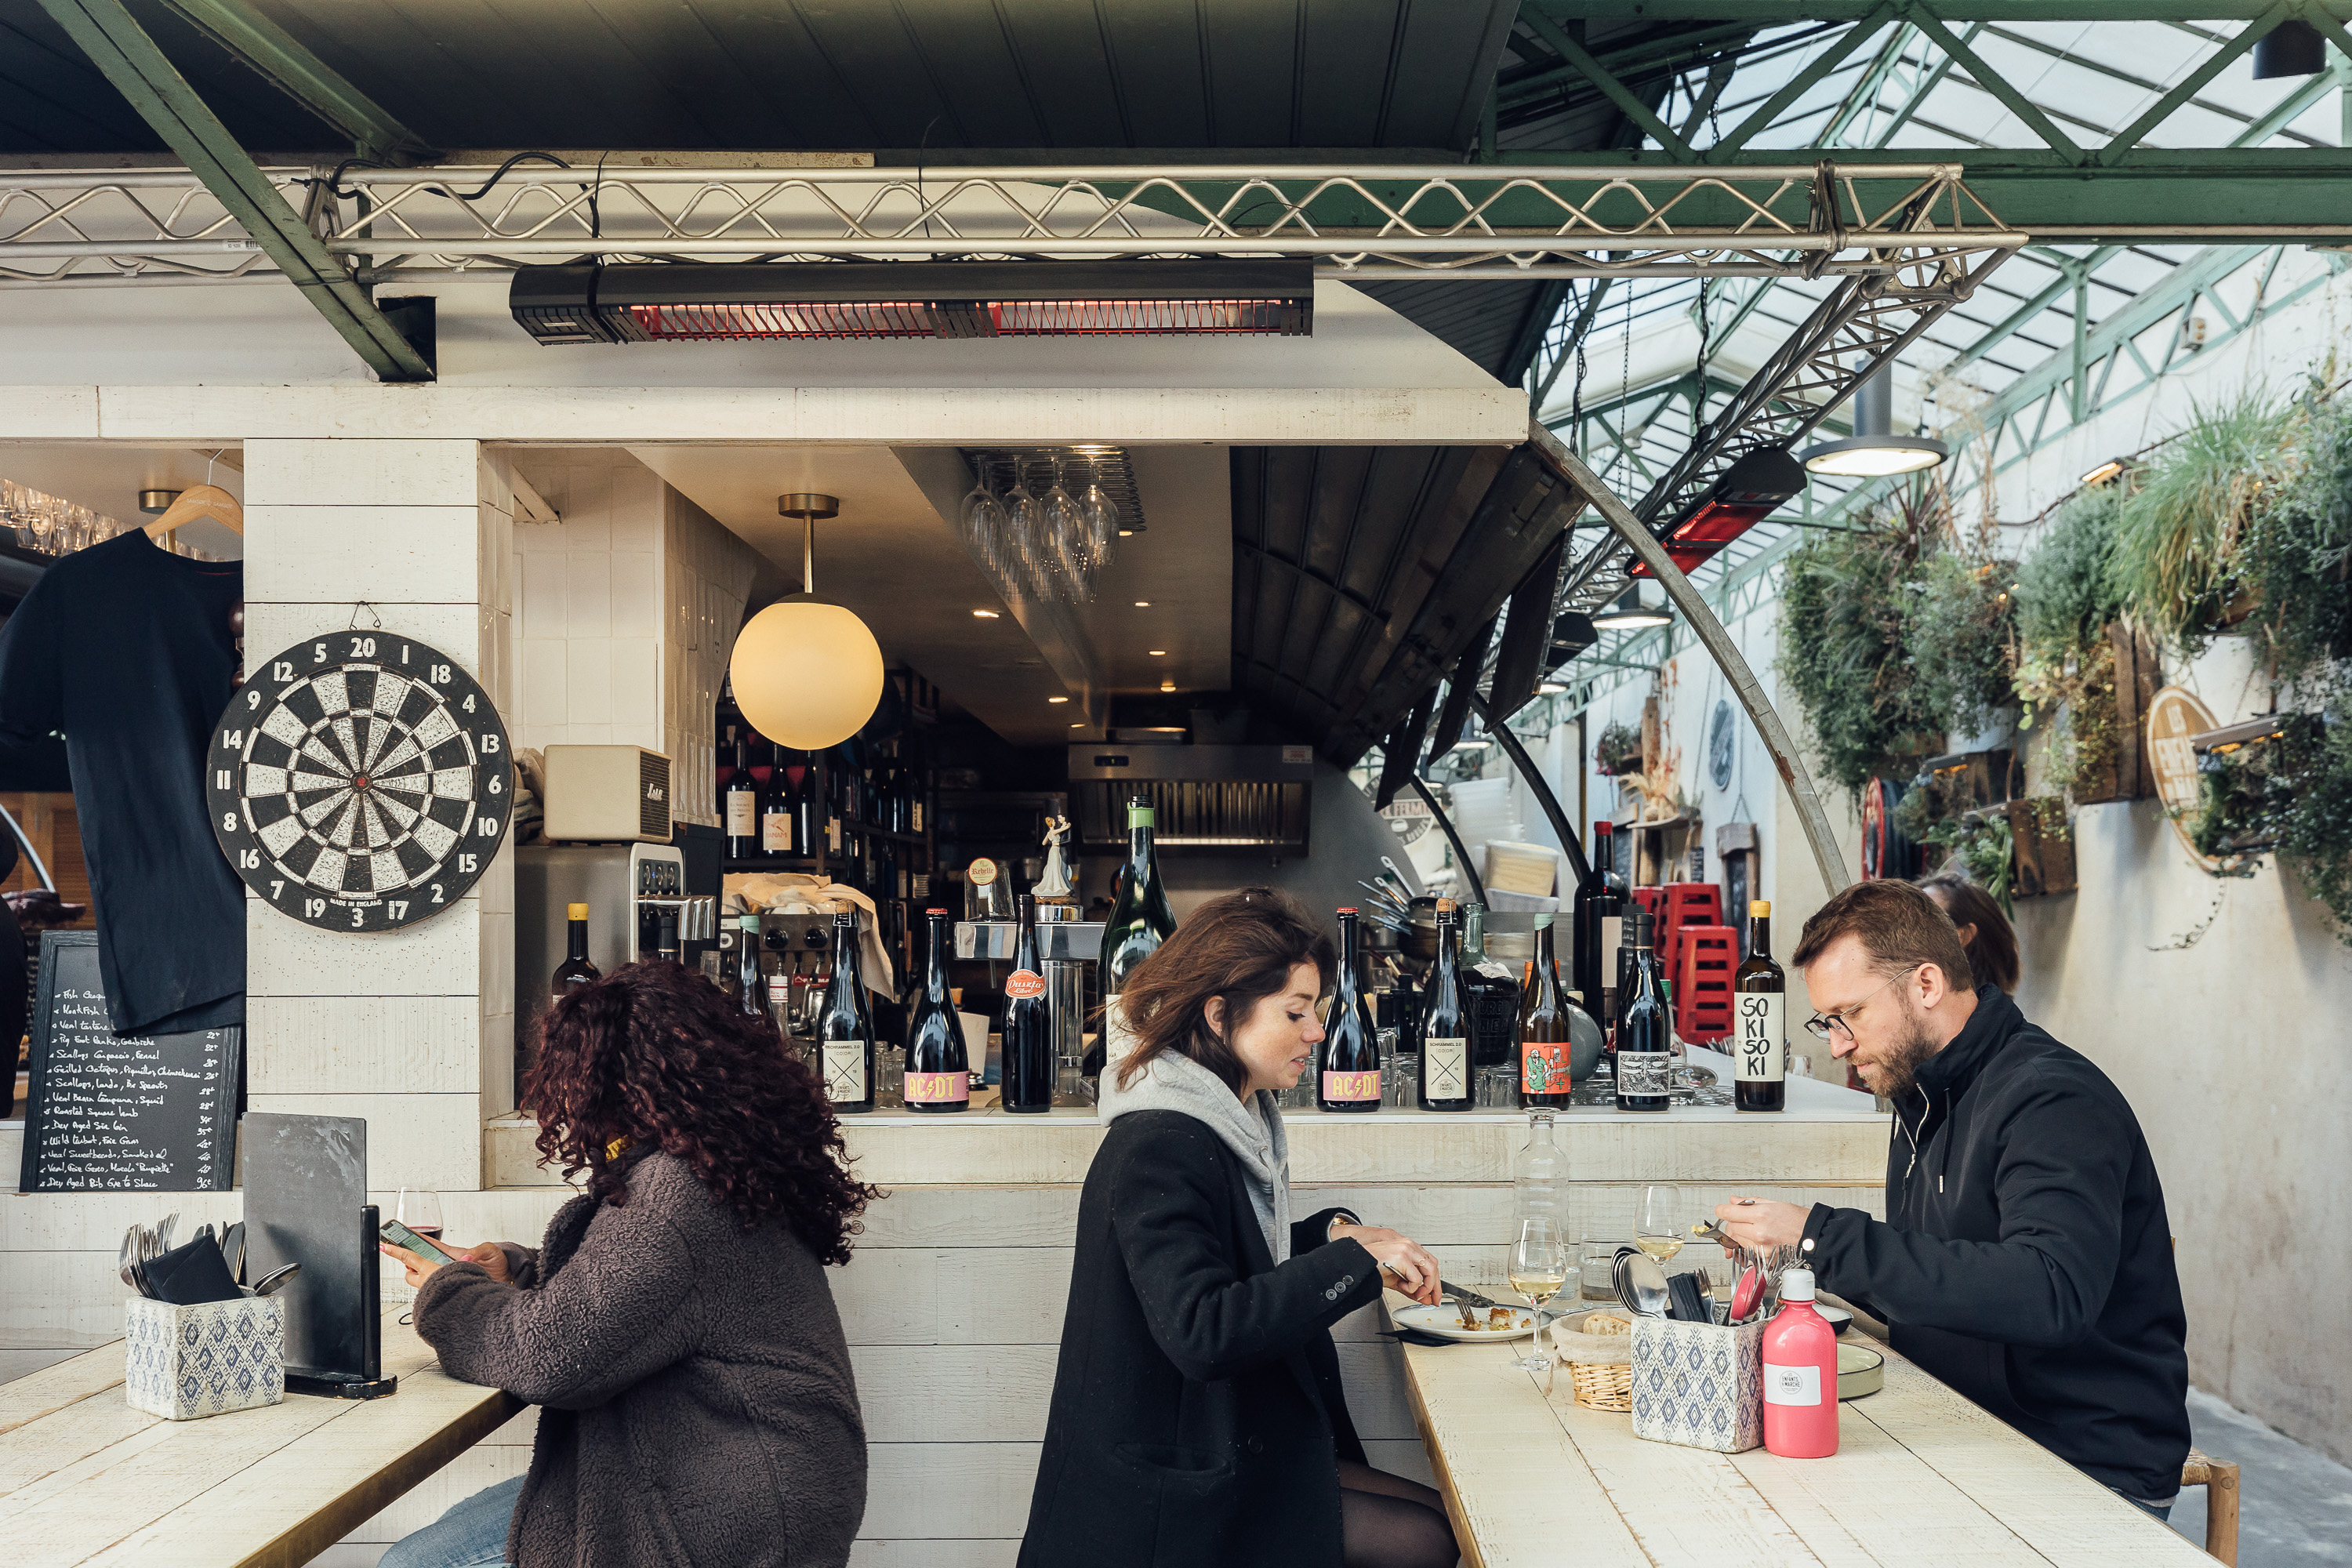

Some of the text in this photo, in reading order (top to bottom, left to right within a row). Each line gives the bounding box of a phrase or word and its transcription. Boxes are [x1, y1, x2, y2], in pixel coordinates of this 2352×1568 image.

[314, 643, 328, 663] 5
[350, 637, 376, 659] 20
[401, 644, 409, 664] 1
[274, 662, 294, 682] 12
[430, 664, 452, 684] 18
[247, 690, 261, 710] 9
[462, 694, 476, 713] 4
[223, 730, 243, 750] 14
[481, 734, 500, 754] 13
[216, 769, 231, 790] 11
[488, 775, 502, 794] 6
[223, 811, 238, 832] 8
[477, 817, 499, 837] 10
[240, 849, 260, 869] 16
[459, 854, 477, 873] 15
[270, 880, 285, 900] 7
[430, 884, 444, 903] 2
[305, 898, 326, 918] 19
[329, 898, 347, 906] MADE
[387, 900, 409, 920] 17
[351, 908, 364, 927] 3
[63, 989, 78, 999] Fish
[1740, 997, 1769, 1017] SO
[59, 1020, 78, 1029] Veal
[1745, 1018, 1764, 1038] KI
[59, 1033, 70, 1047] Pig
[1743, 1039, 1770, 1054] SO
[56, 1049, 89, 1061] Scallops
[135, 1050, 159, 1059] Fennel
[53, 1063, 82, 1073] Grilled
[1748, 1056, 1765, 1076] KI
[53, 1092, 71, 1102] Veal
[140, 1094, 163, 1106] Squid
[72, 1120, 91, 1132] Aged
[49, 1134, 70, 1145] Wild
[48, 1149, 67, 1158] Veal
[67, 1176, 85, 1189] Aged
[122, 1174, 131, 1187] to
